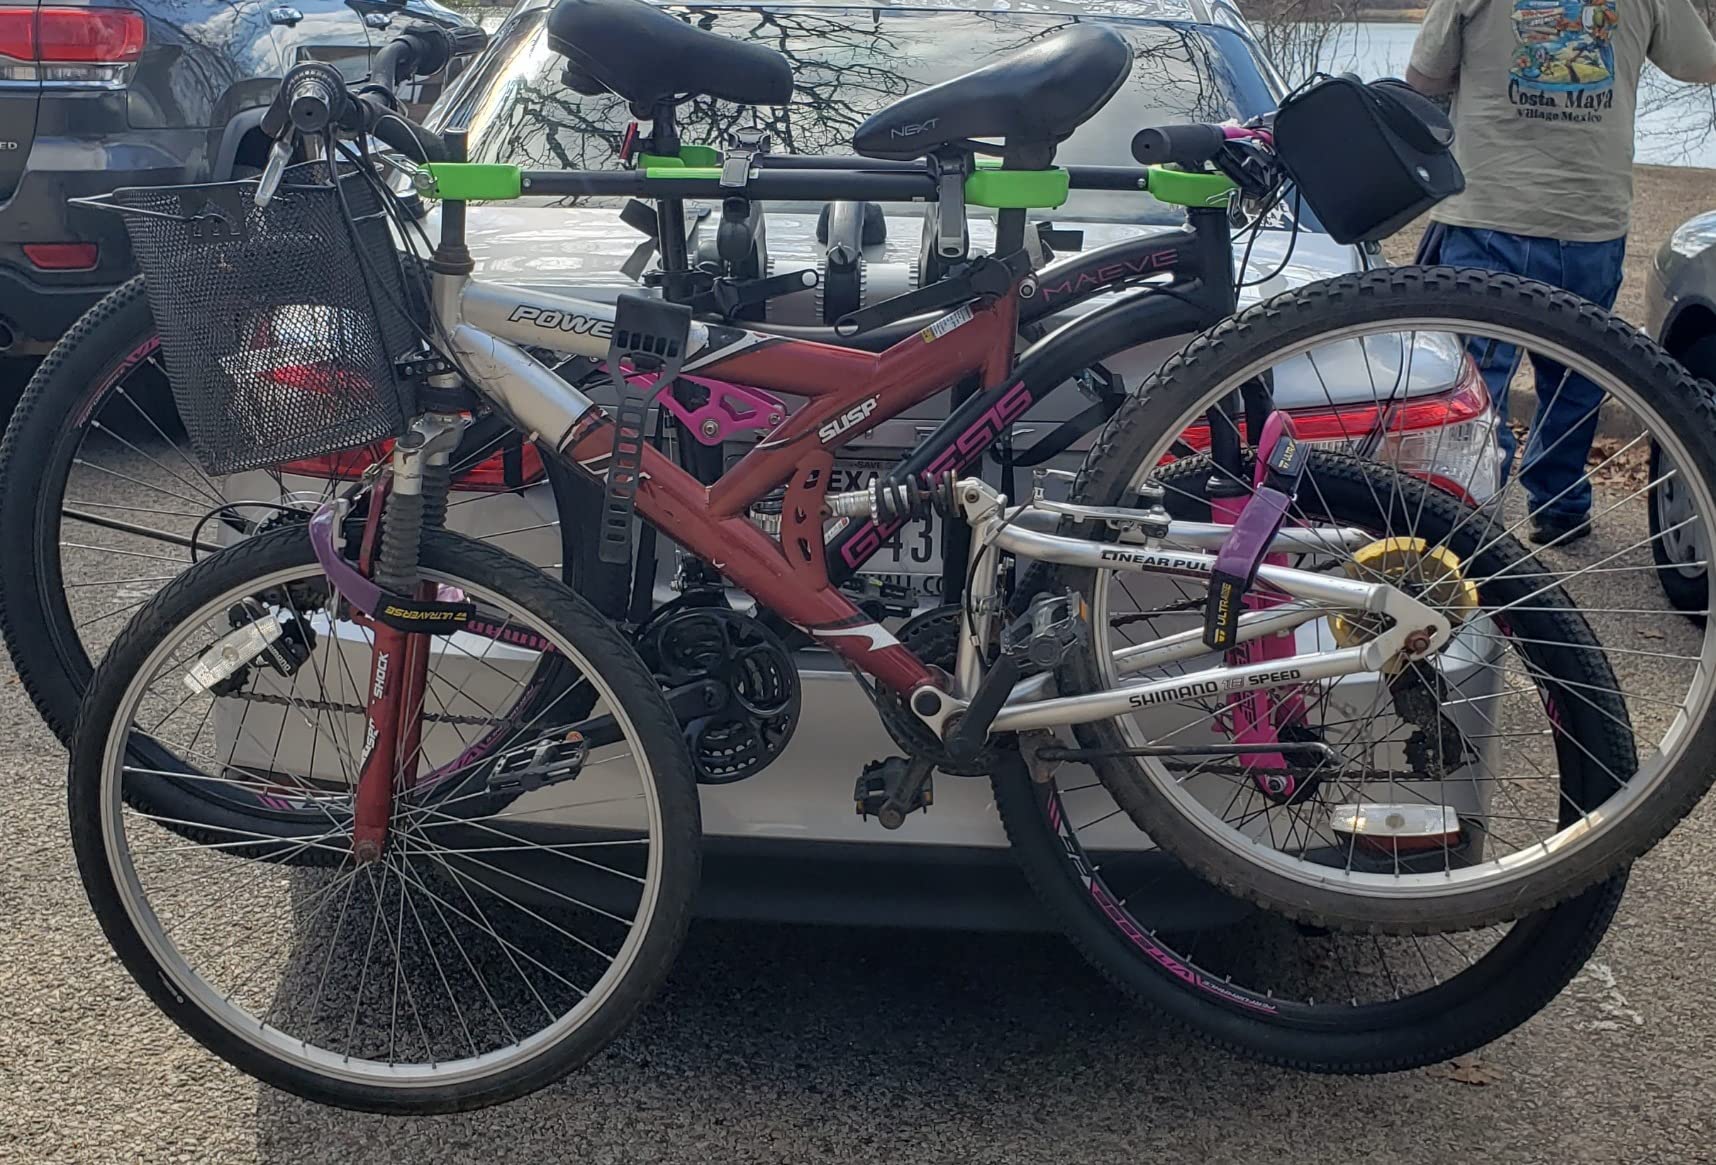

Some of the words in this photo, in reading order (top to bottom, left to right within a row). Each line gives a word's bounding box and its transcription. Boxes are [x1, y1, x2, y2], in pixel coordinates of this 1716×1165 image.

[1508, 79, 1556, 107] Costa
[1565, 88, 1613, 112] Maya
[891, 118, 940, 139] NEXT
[1042, 249, 1179, 301] MAEVE
[507, 304, 615, 339] POWE
[1173, 559, 1210, 572] PUL
[384, 605, 454, 620] ULTRAVERSE
[374, 650, 390, 700] SHOCK
[1128, 681, 1219, 708] SHIMANO
[1247, 669, 1301, 687] SPEED
